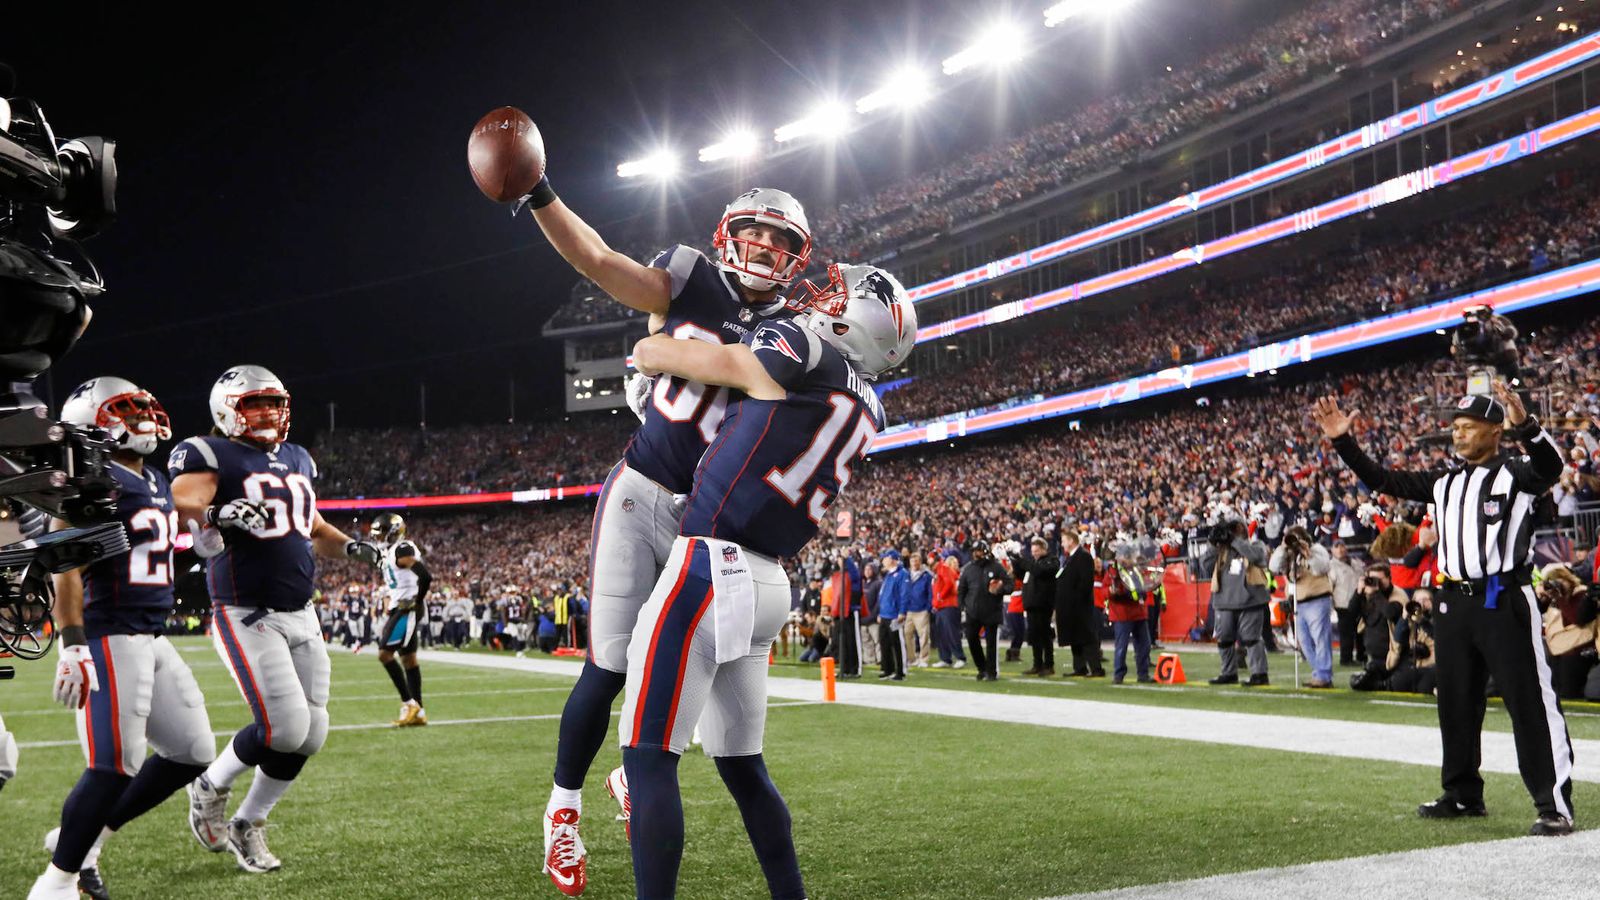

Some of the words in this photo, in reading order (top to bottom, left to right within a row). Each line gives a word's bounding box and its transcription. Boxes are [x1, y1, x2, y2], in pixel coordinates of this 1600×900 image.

[763, 392, 877, 525] 15
[242, 472, 316, 540] 60
[837, 511, 851, 537] 2
[1157, 656, 1173, 681] G
